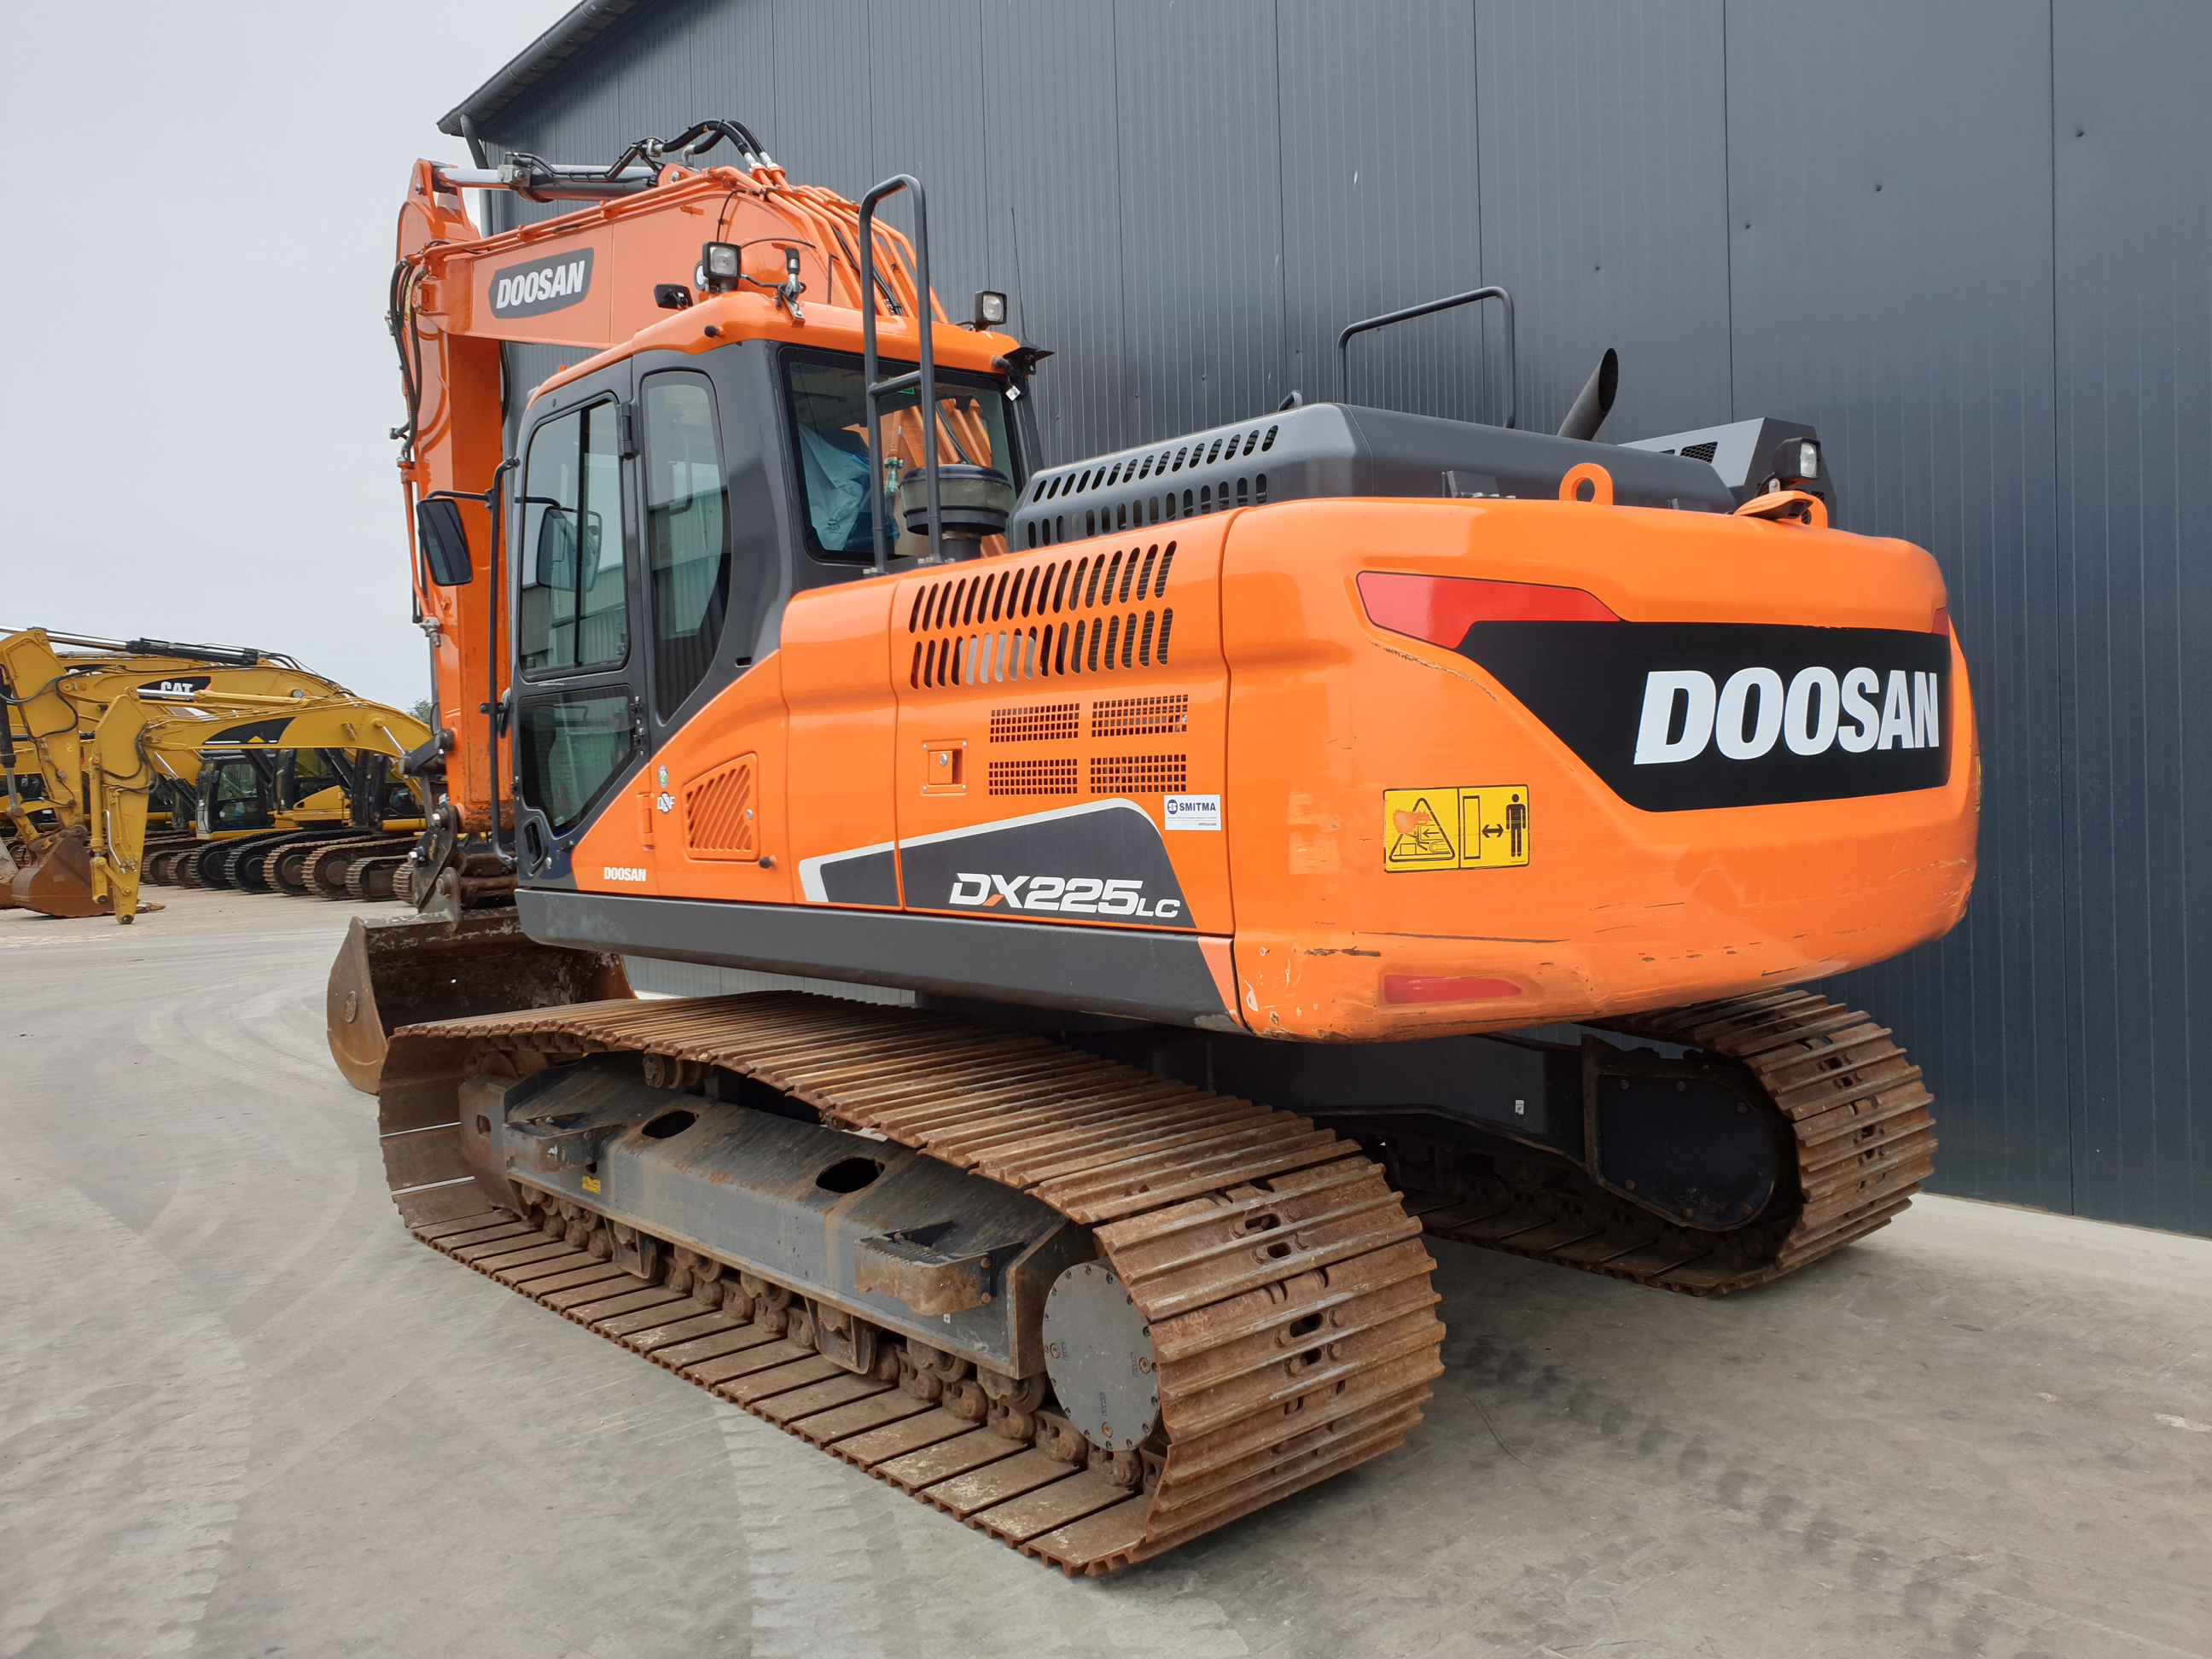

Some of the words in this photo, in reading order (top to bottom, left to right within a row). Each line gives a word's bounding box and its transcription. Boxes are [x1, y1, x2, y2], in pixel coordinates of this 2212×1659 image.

[495, 259, 586, 310] DOOSAN
[160, 681, 195, 694] CAT
[1633, 666, 1940, 765] DOOSAN
[1179, 801, 1217, 812] SMITMA
[603, 866, 647, 882] DOOSAN
